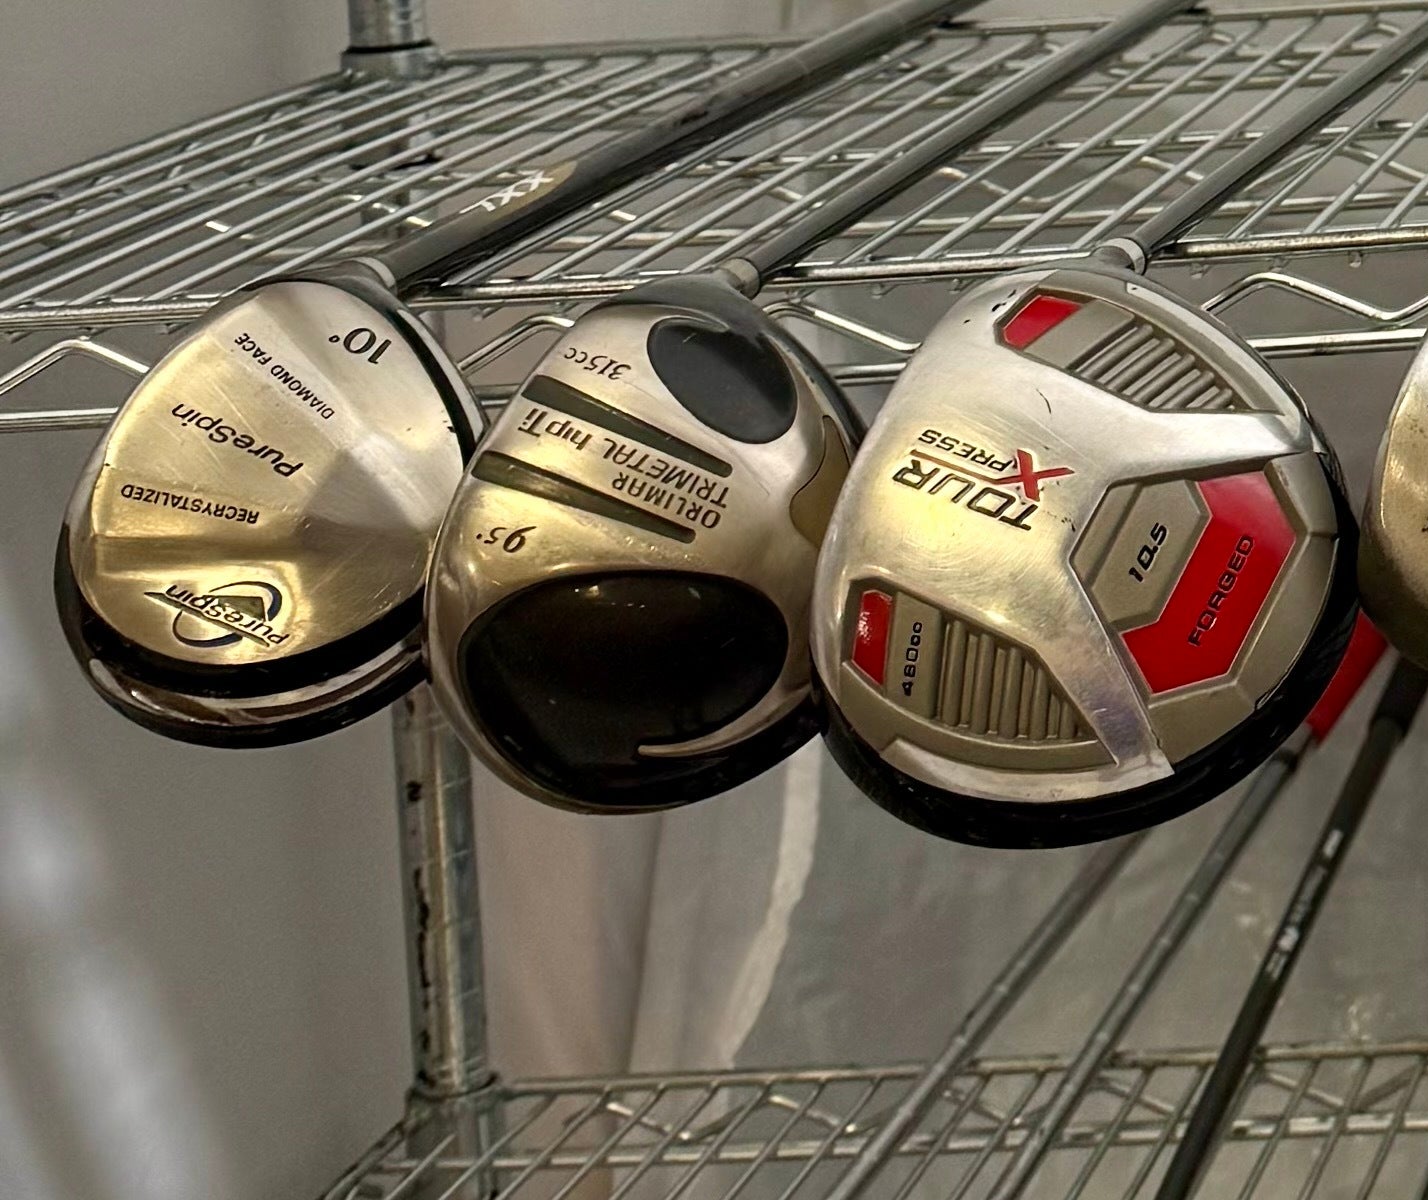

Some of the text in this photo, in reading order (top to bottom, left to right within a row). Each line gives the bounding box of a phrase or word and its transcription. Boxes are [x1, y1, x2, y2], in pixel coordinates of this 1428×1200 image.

[234, 331, 334, 420] DIAMOND FACE
[328, 327, 392, 365] 10°
[564, 346, 631, 381] 315cc
[171, 403, 304, 478] PureSpin
[602, 437, 730, 509] TRIMETAL
[121, 483, 260, 525] RECRYSTALIZED
[613, 471, 721, 529] ORLIMAR
[893, 458, 1040, 532] TOUR
[1187, 533, 1255, 648] FORGED
